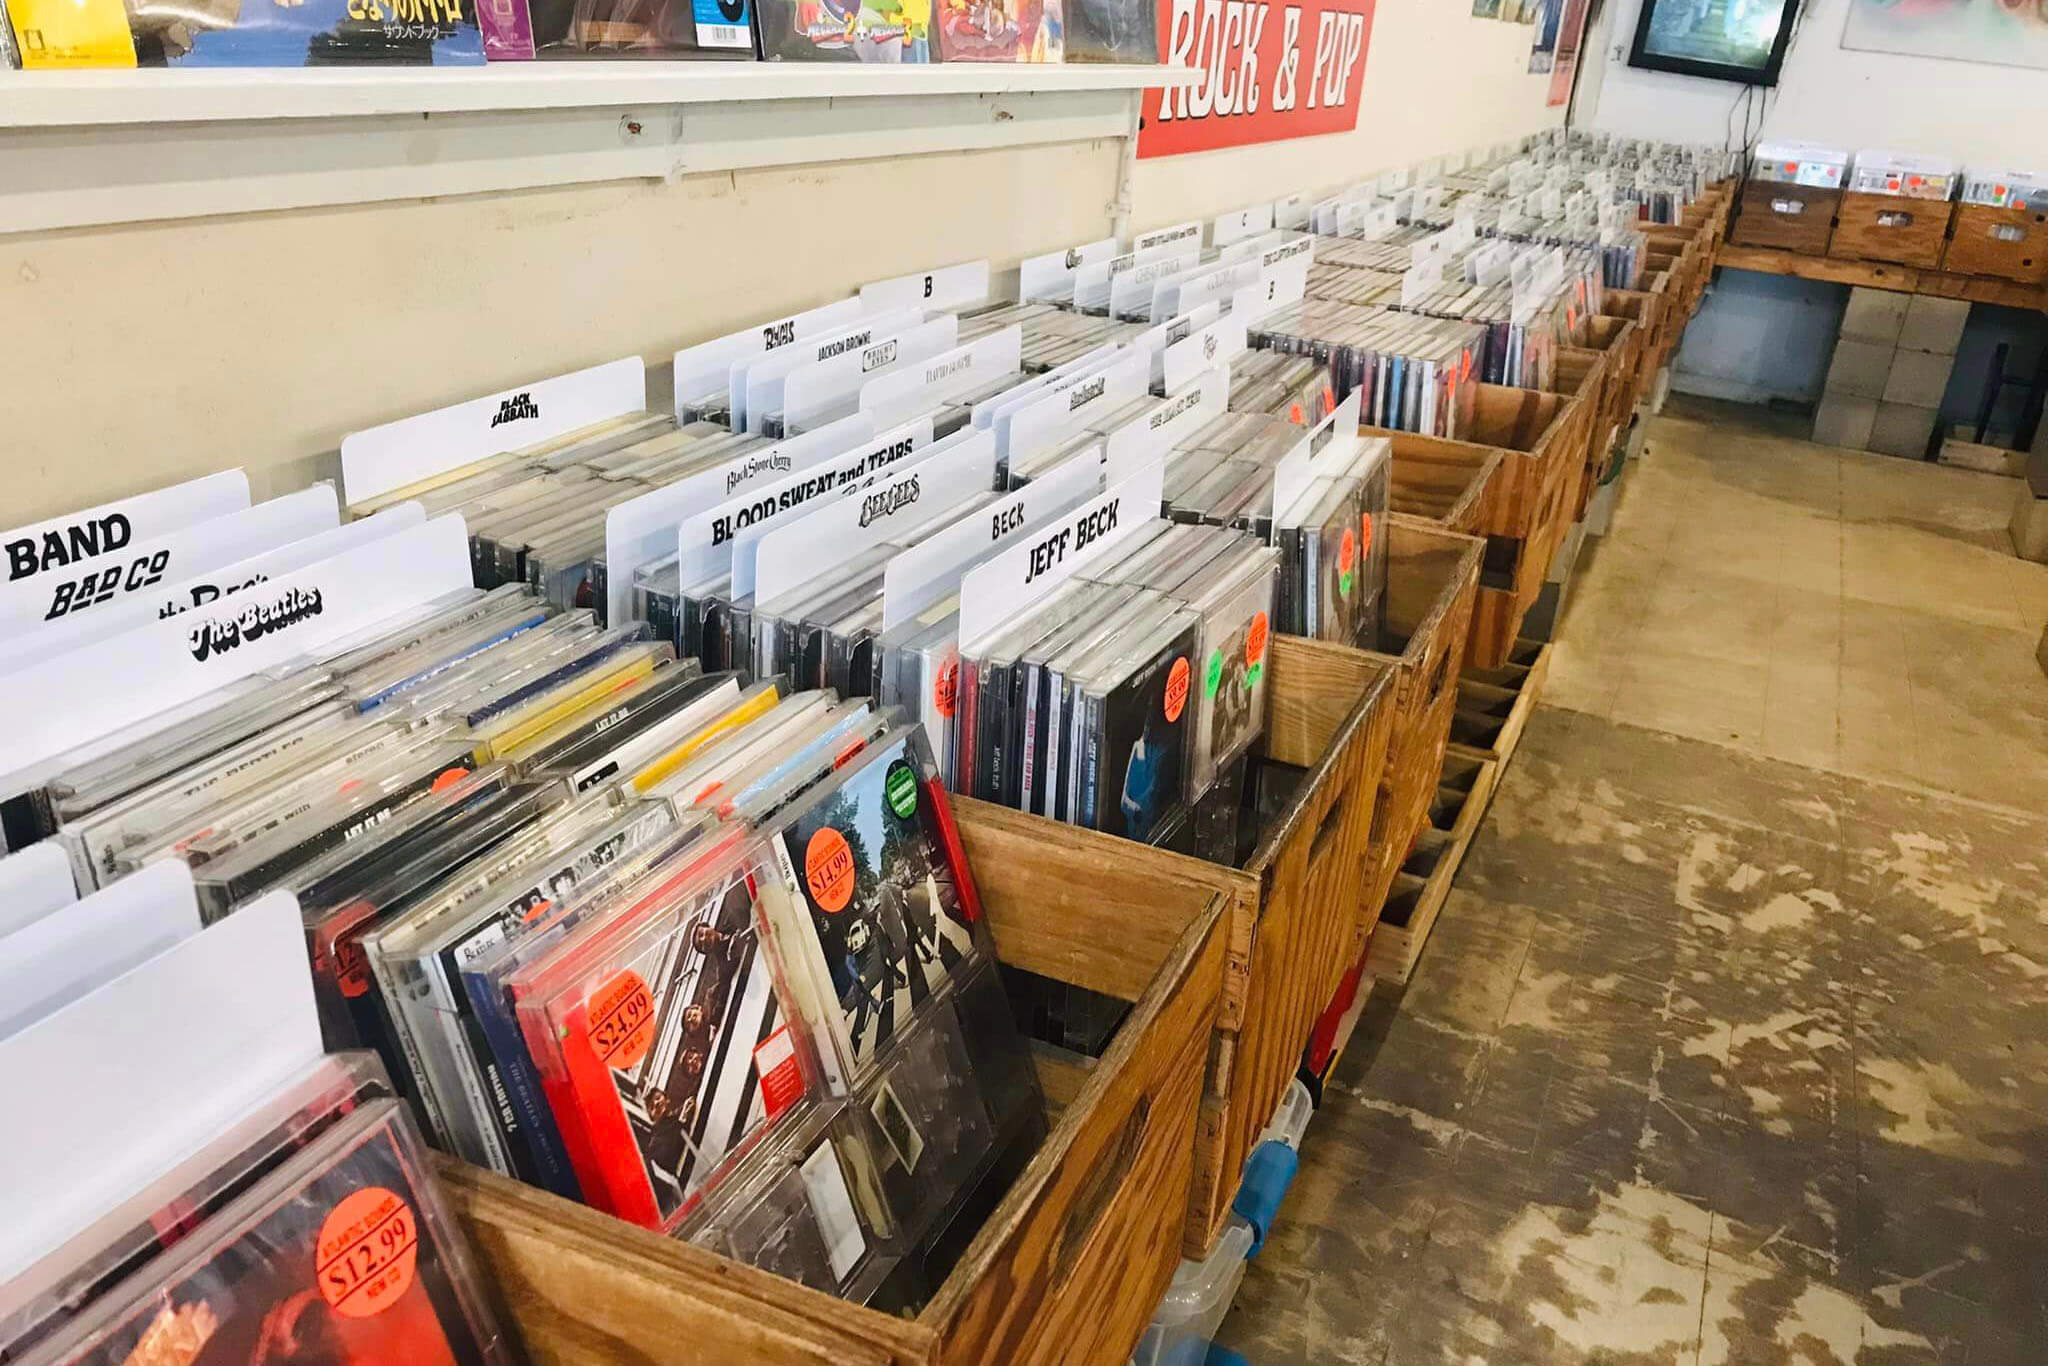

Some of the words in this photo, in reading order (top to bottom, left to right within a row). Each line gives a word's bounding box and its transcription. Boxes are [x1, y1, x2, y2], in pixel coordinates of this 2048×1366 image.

[1158, 0, 1270, 121] ROCK
[1272, 5, 1302, 112] &
[1306, 9, 1365, 110] POP
[924, 275, 933, 298] B
[818, 340, 845, 361] JACKSON
[490, 403, 539, 429] SABBATH
[500, 392, 531, 412] BLACK
[712, 497, 777, 547] BLOOD
[779, 469, 837, 513] SWEAT
[837, 457, 865, 487] and
[866, 438, 914, 472] TEARS
[992, 501, 1025, 541] BECK
[4, 513, 131, 582] BAND
[1025, 527, 1071, 584] JEFF
[1075, 498, 1120, 552] BECK
[44, 566, 122, 621] BAD
[187, 617, 241, 662] The
[238, 586, 323, 642] Beatles
[811, 851, 849, 896] $14.99
[595, 992, 648, 1055] $24.99
[328, 1217, 408, 1298] $12.99
